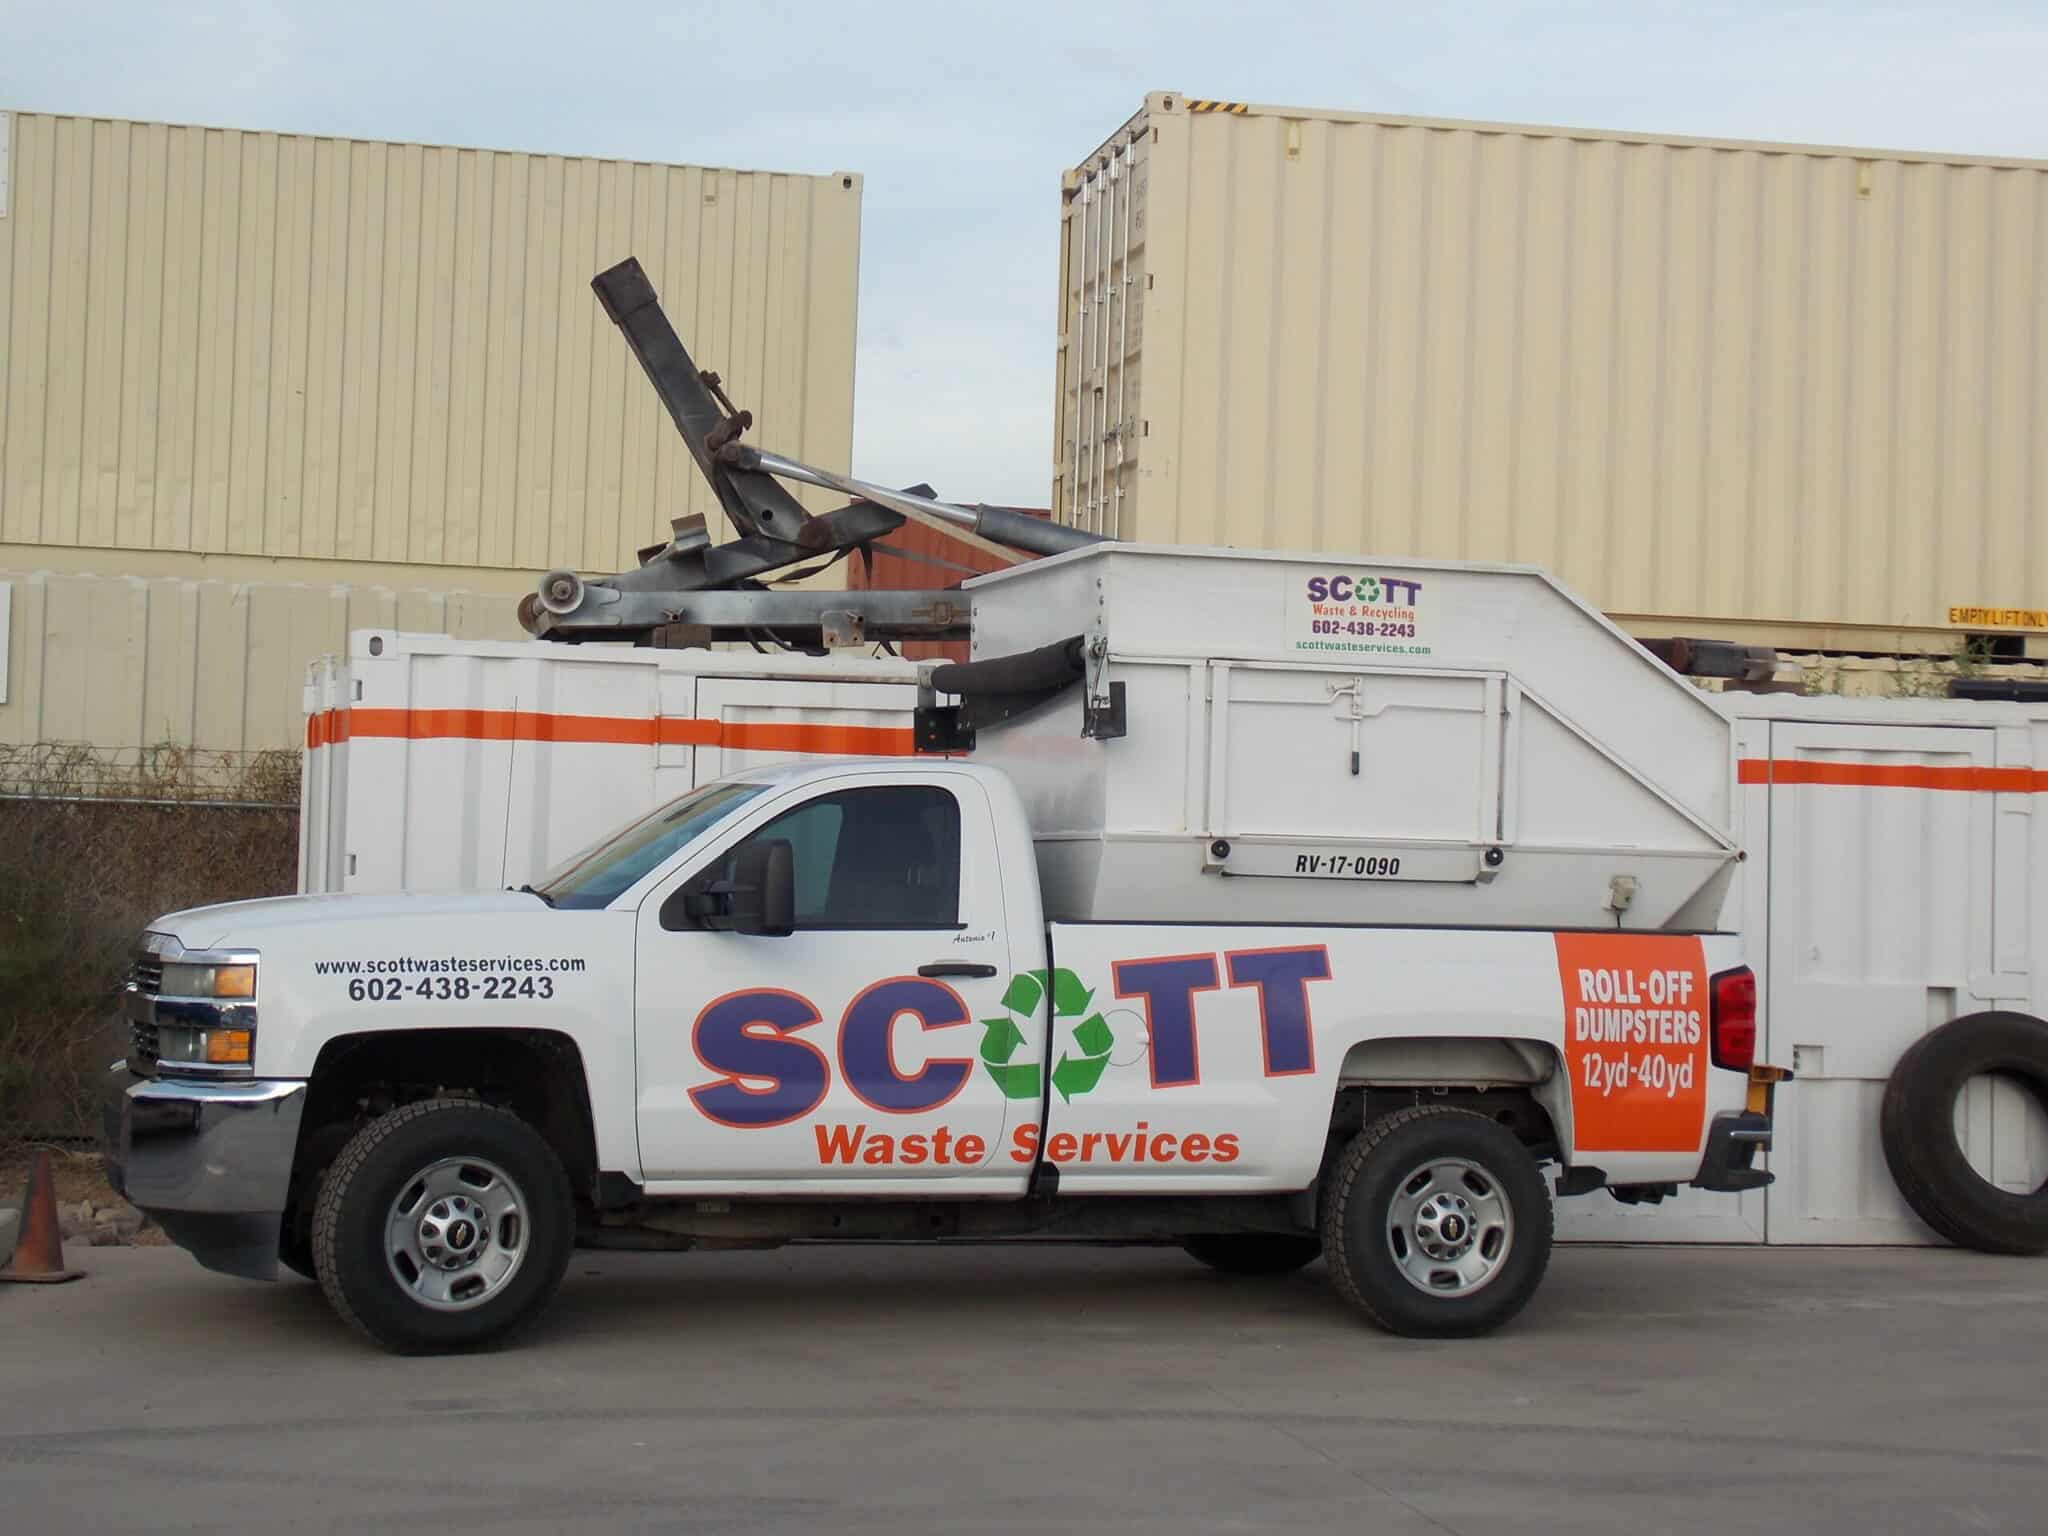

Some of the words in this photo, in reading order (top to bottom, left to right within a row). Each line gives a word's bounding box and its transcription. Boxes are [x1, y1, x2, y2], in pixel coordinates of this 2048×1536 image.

[1307, 576, 1422, 606] SCOTT
[1313, 604, 1345, 617] Waste
[1350, 606, 1357, 616] &
[1362, 606, 1415, 621] Recycling
[1950, 608, 1989, 625] EMPTY
[1991, 608, 2020, 625] LIFT
[1312, 620, 1415, 638] 602-438-2243
[1296, 641, 1431, 655] scottwasteservices.com
[1296, 855, 1400, 875] RV-17-0090
[315, 956, 586, 974] www.scottwasteservices.com
[349, 976, 554, 1001] 602-438-2243
[1578, 968, 1693, 1004] ROLL-OFF
[686, 943, 1332, 1129] SCOTT
[1576, 1007, 1701, 1044] DUMPSTERS
[1582, 1051, 1694, 1098] 12yd-40yd
[814, 1124, 985, 1165] Waste
[1009, 1121, 1240, 1164] Services
